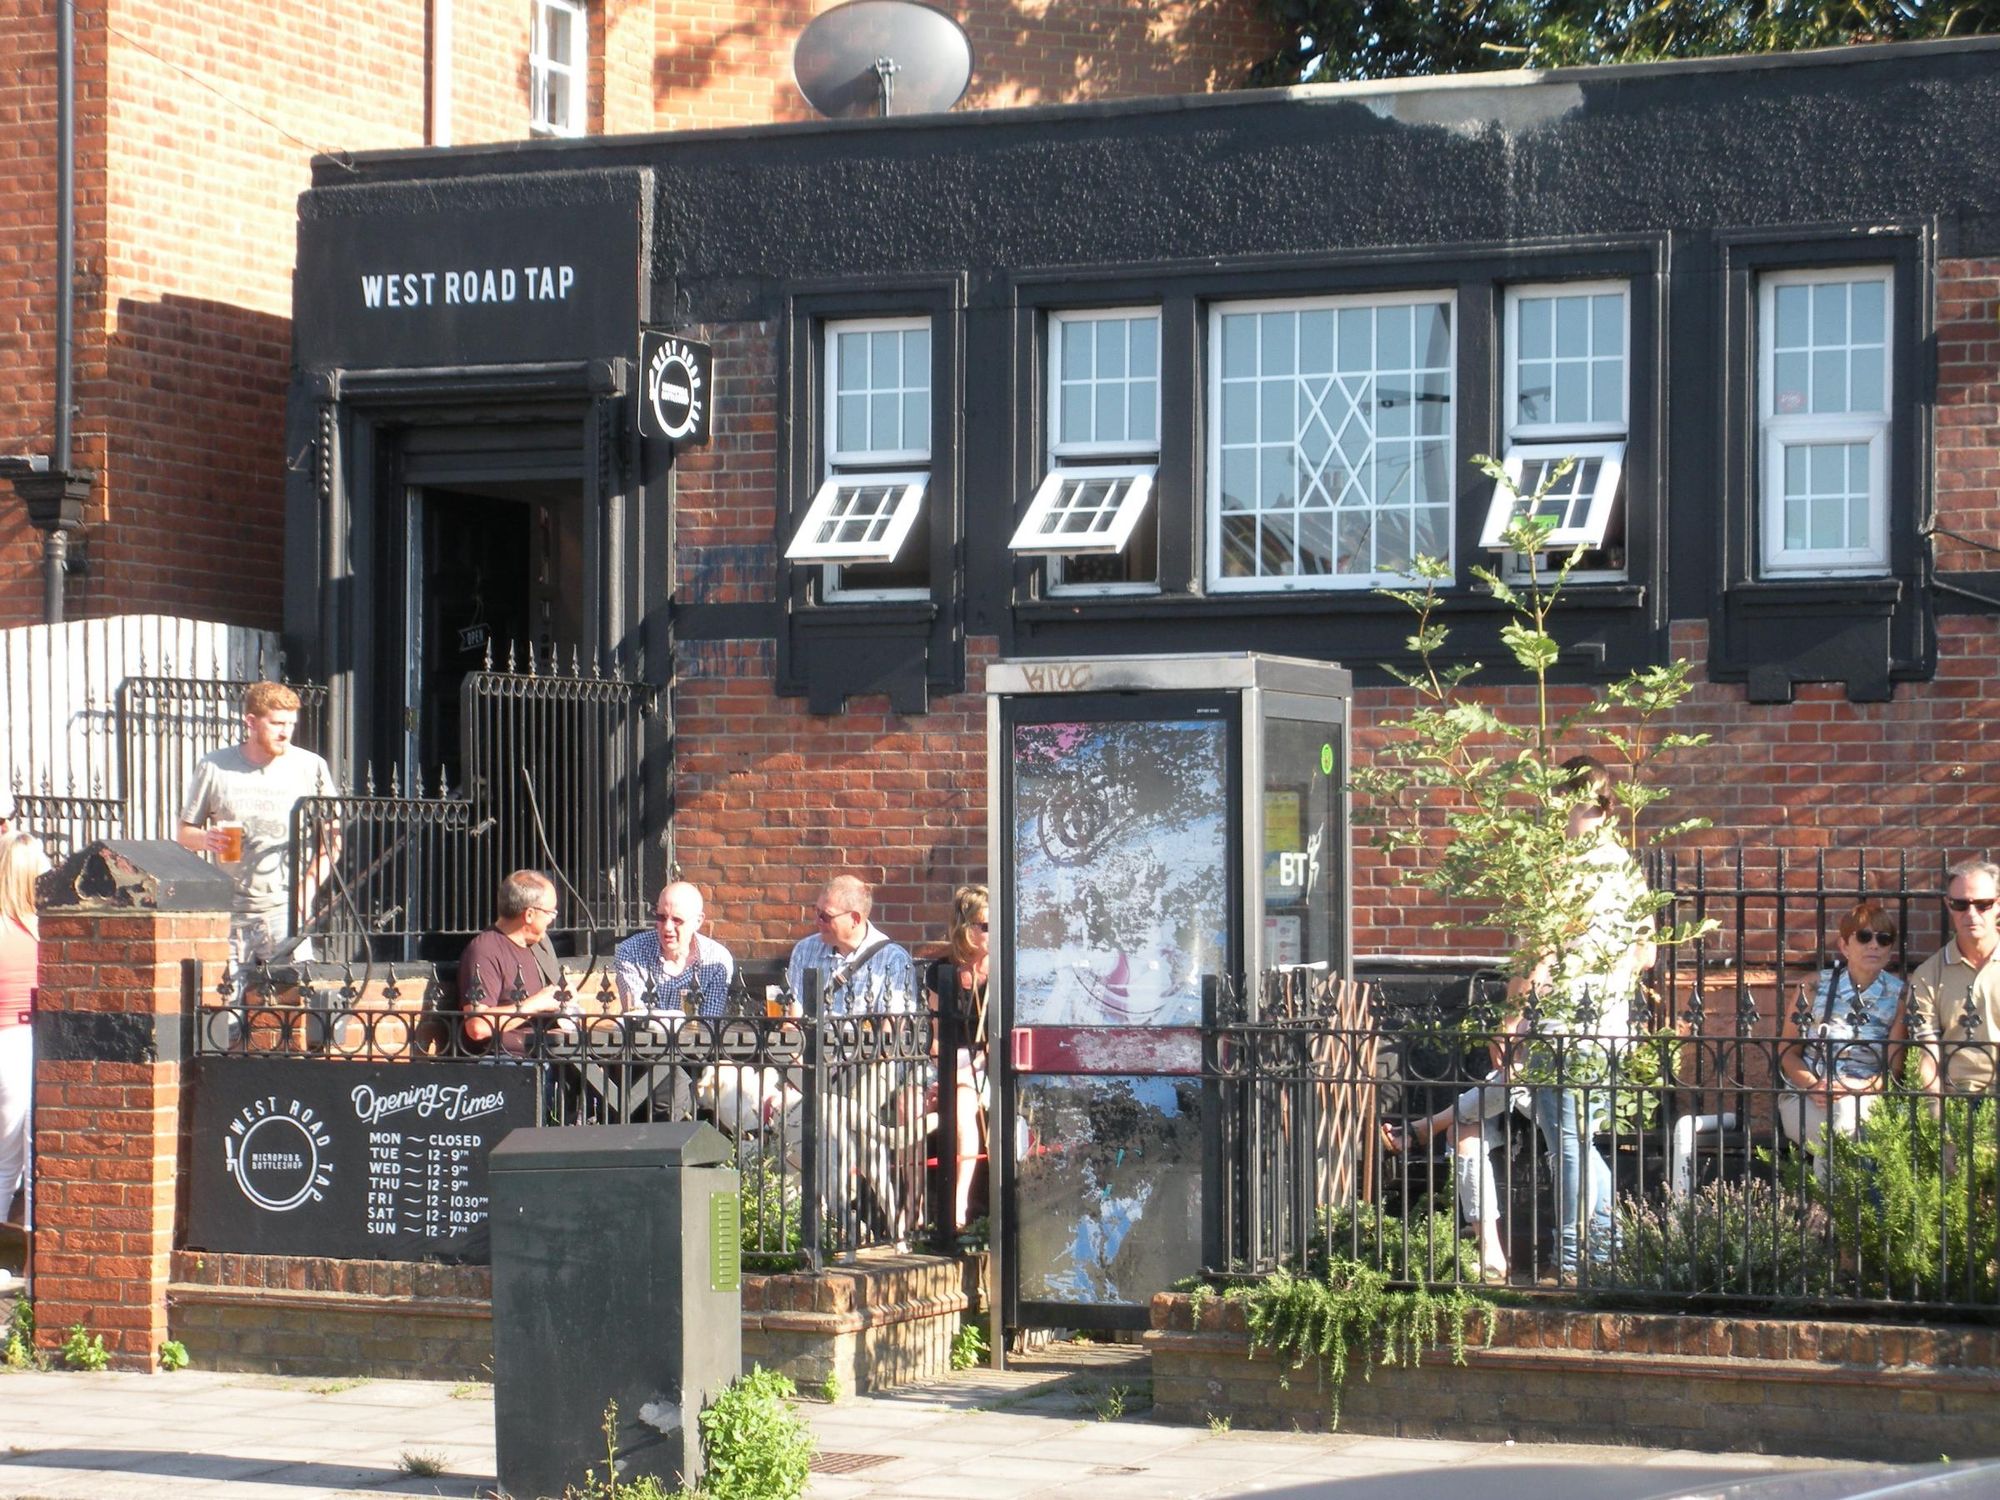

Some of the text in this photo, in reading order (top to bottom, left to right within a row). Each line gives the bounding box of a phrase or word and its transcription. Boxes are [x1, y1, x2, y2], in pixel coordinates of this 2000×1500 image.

[361, 265, 575, 309] WEST ROAD TAP
[466, 628, 485, 646] OPEN
[1279, 851, 1309, 887] BT
[351, 1083, 505, 1125] Opening Times
[369, 1131, 482, 1147] MON CLOSED
[229, 1095, 334, 1203] WEST ROAD TAP
[369, 1147, 400, 1160] TUE
[251, 1152, 293, 1162] MICROPUB
[251, 1160, 304, 1171] BOTTLESHOP
[368, 1161, 402, 1175] WED
[368, 1177, 401, 1190] THU
[367, 1191, 393, 1205] FRI
[367, 1206, 395, 1219] SAT
[366, 1221, 397, 1235] SUN
